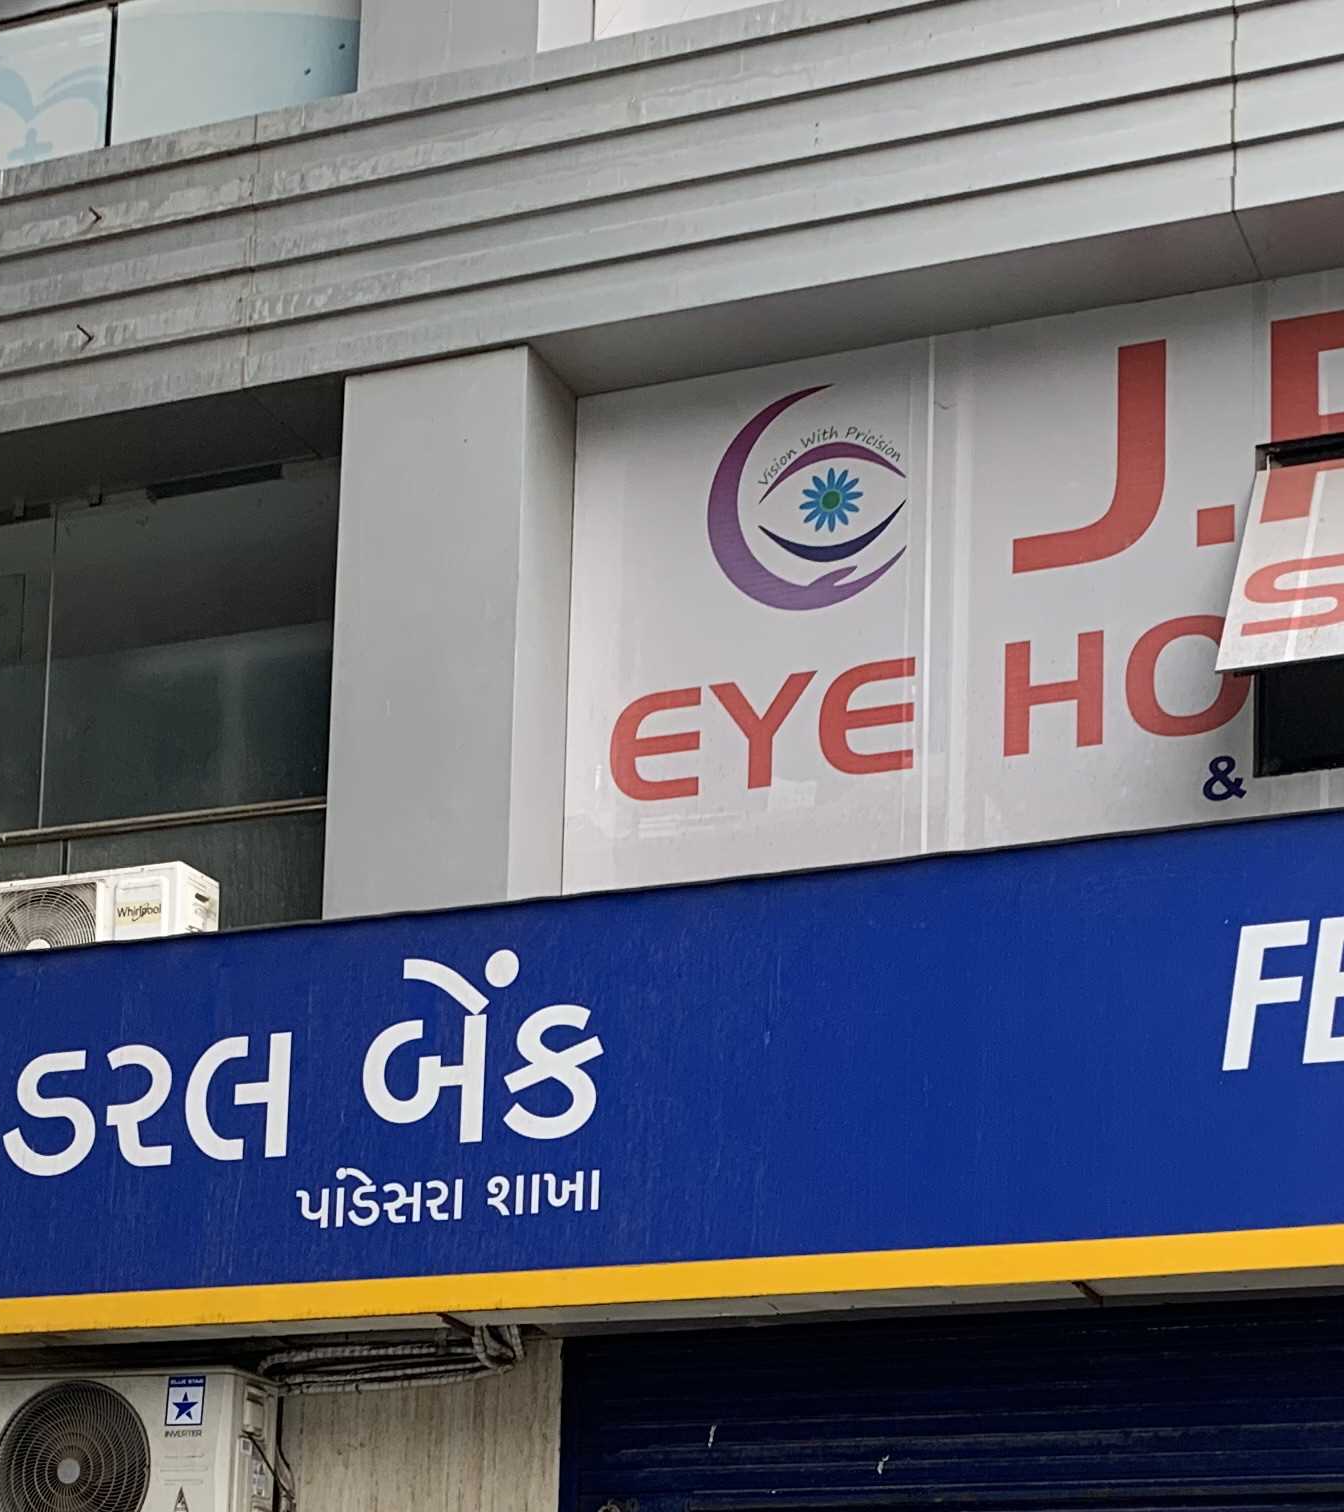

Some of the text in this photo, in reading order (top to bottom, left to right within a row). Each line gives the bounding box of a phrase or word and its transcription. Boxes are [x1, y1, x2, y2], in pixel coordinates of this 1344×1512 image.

[758, 425, 902, 487] Vision With Pricision
[610, 655, 917, 803] EYE
[1202, 755, 1247, 802] &
[116, 902, 162, 922] Whirlpool
[486, 1168, 601, 1216] શાખા
